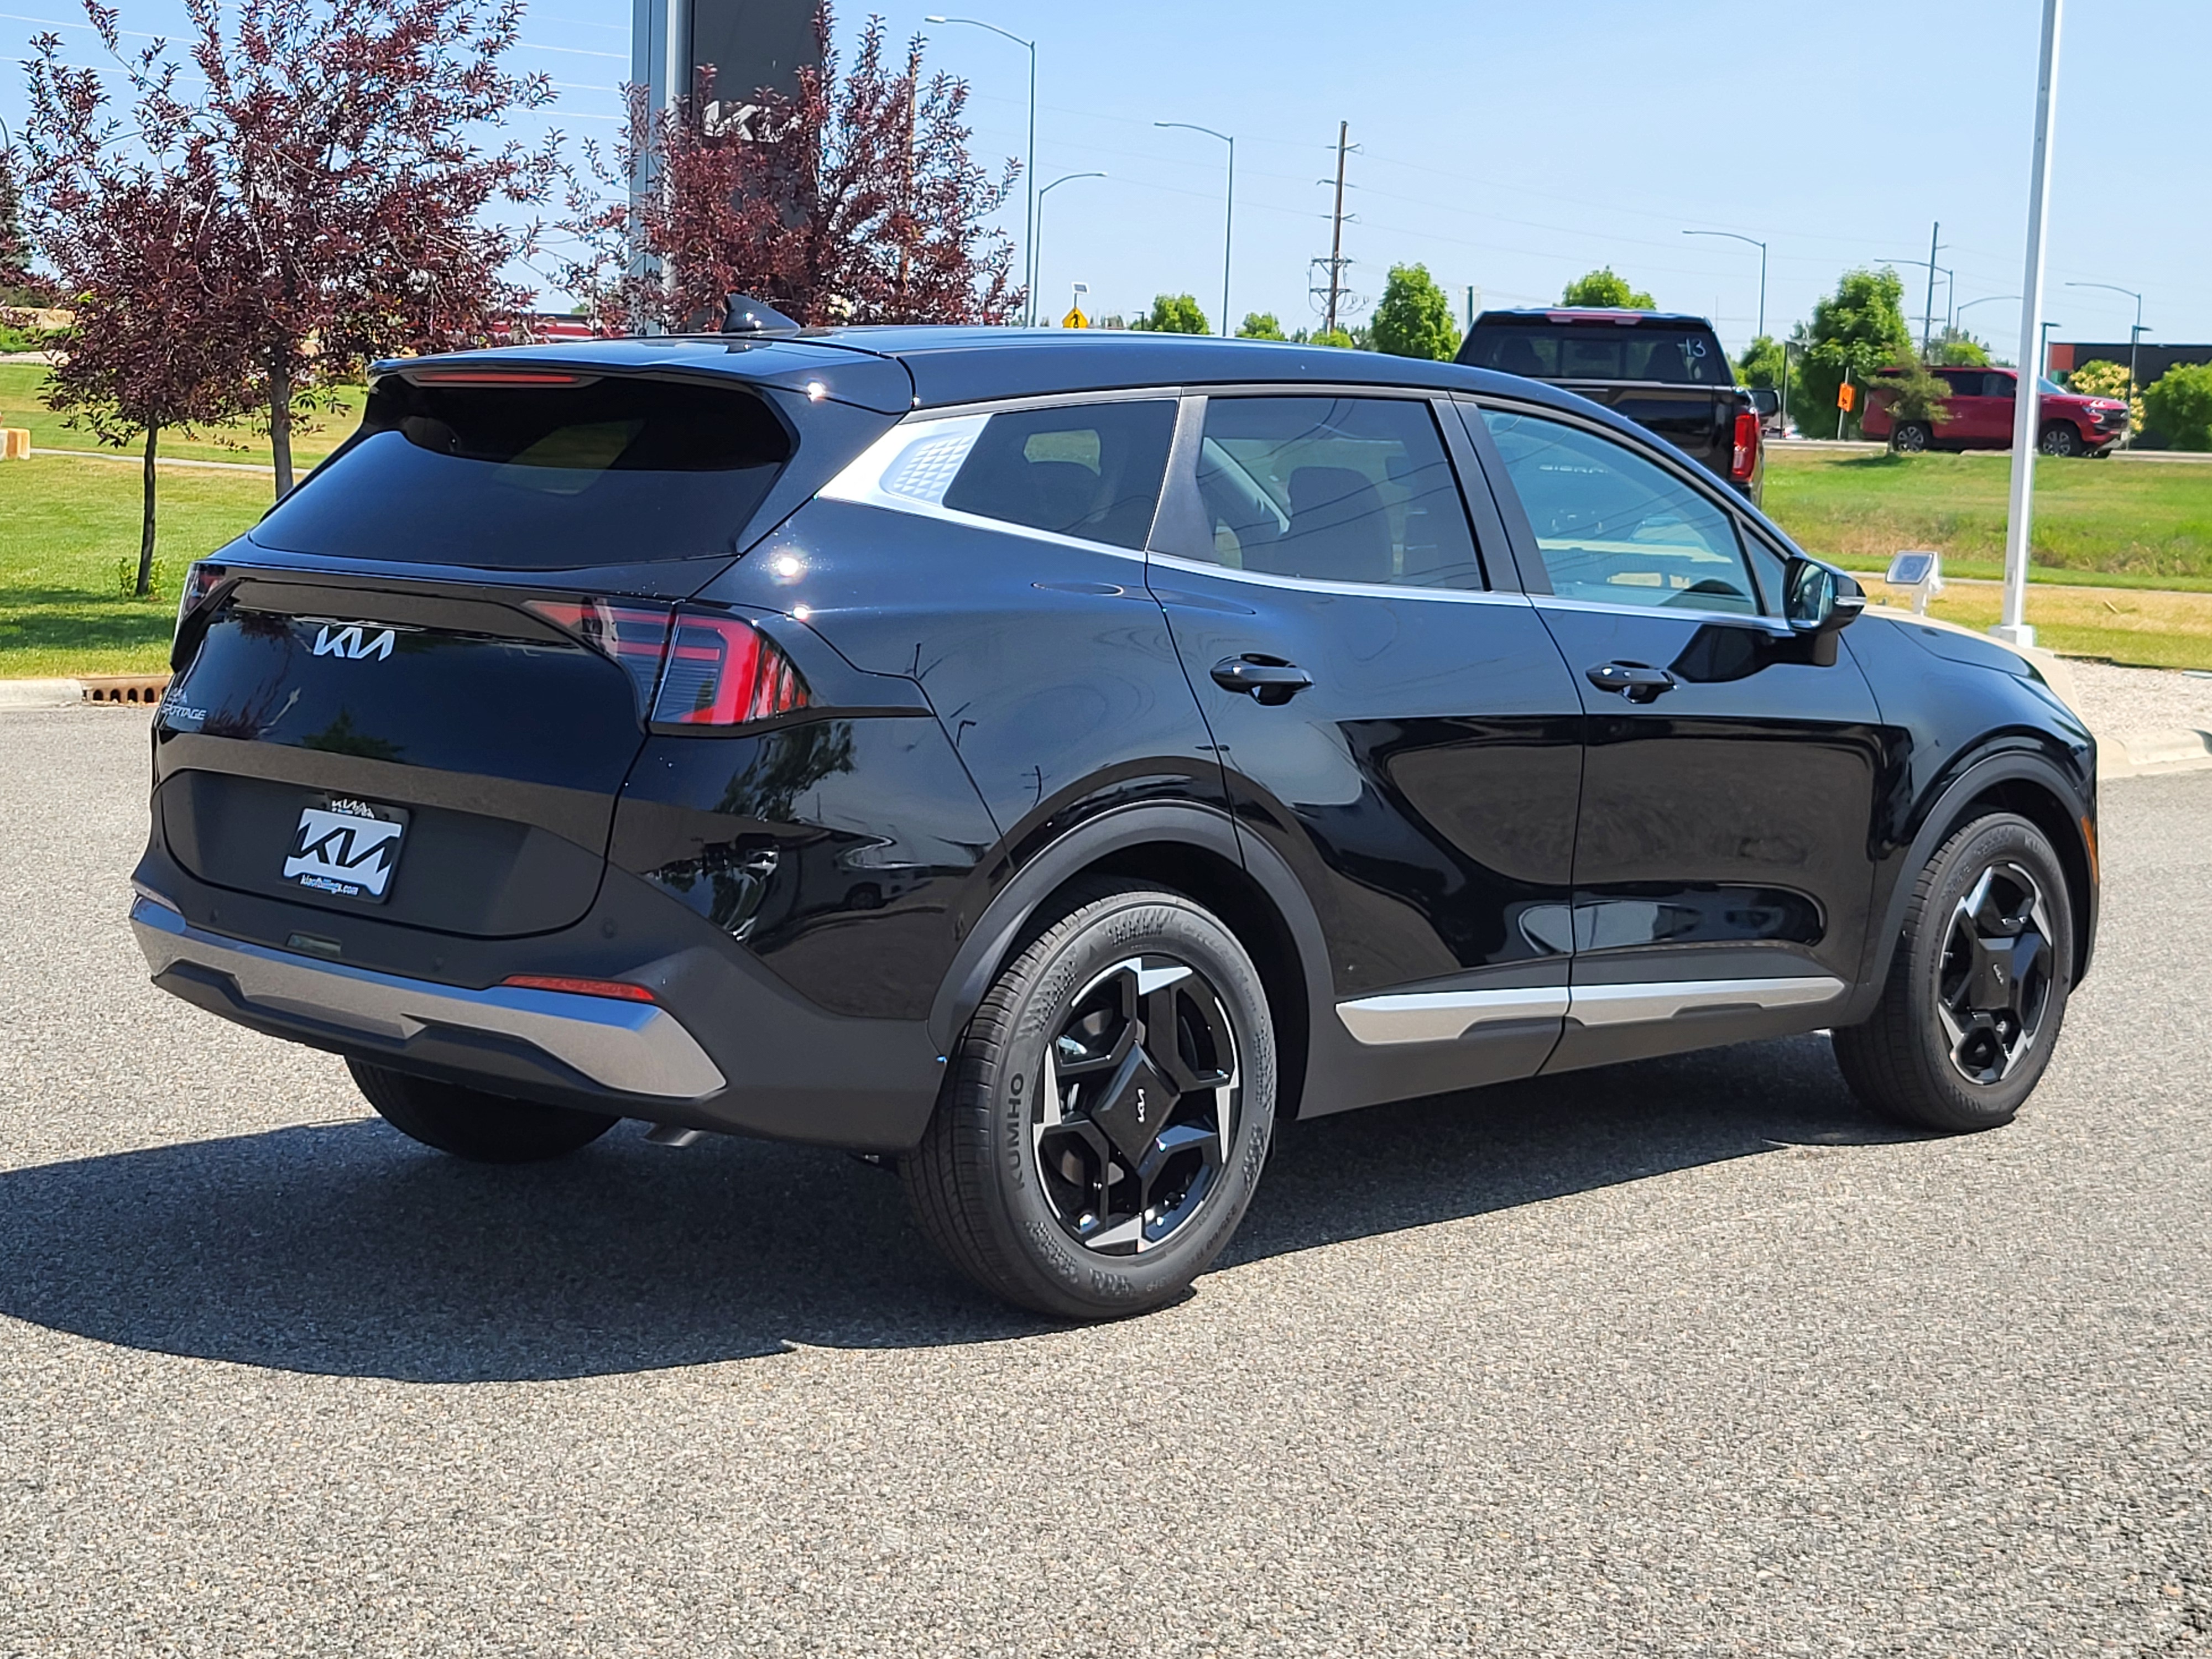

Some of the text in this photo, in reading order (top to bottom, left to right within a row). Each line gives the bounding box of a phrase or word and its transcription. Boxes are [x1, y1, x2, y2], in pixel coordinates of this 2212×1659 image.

[313, 625, 395, 661] KIA
[289, 821, 400, 874] KIA
[1006, 1072, 1025, 1190] KUMHO
